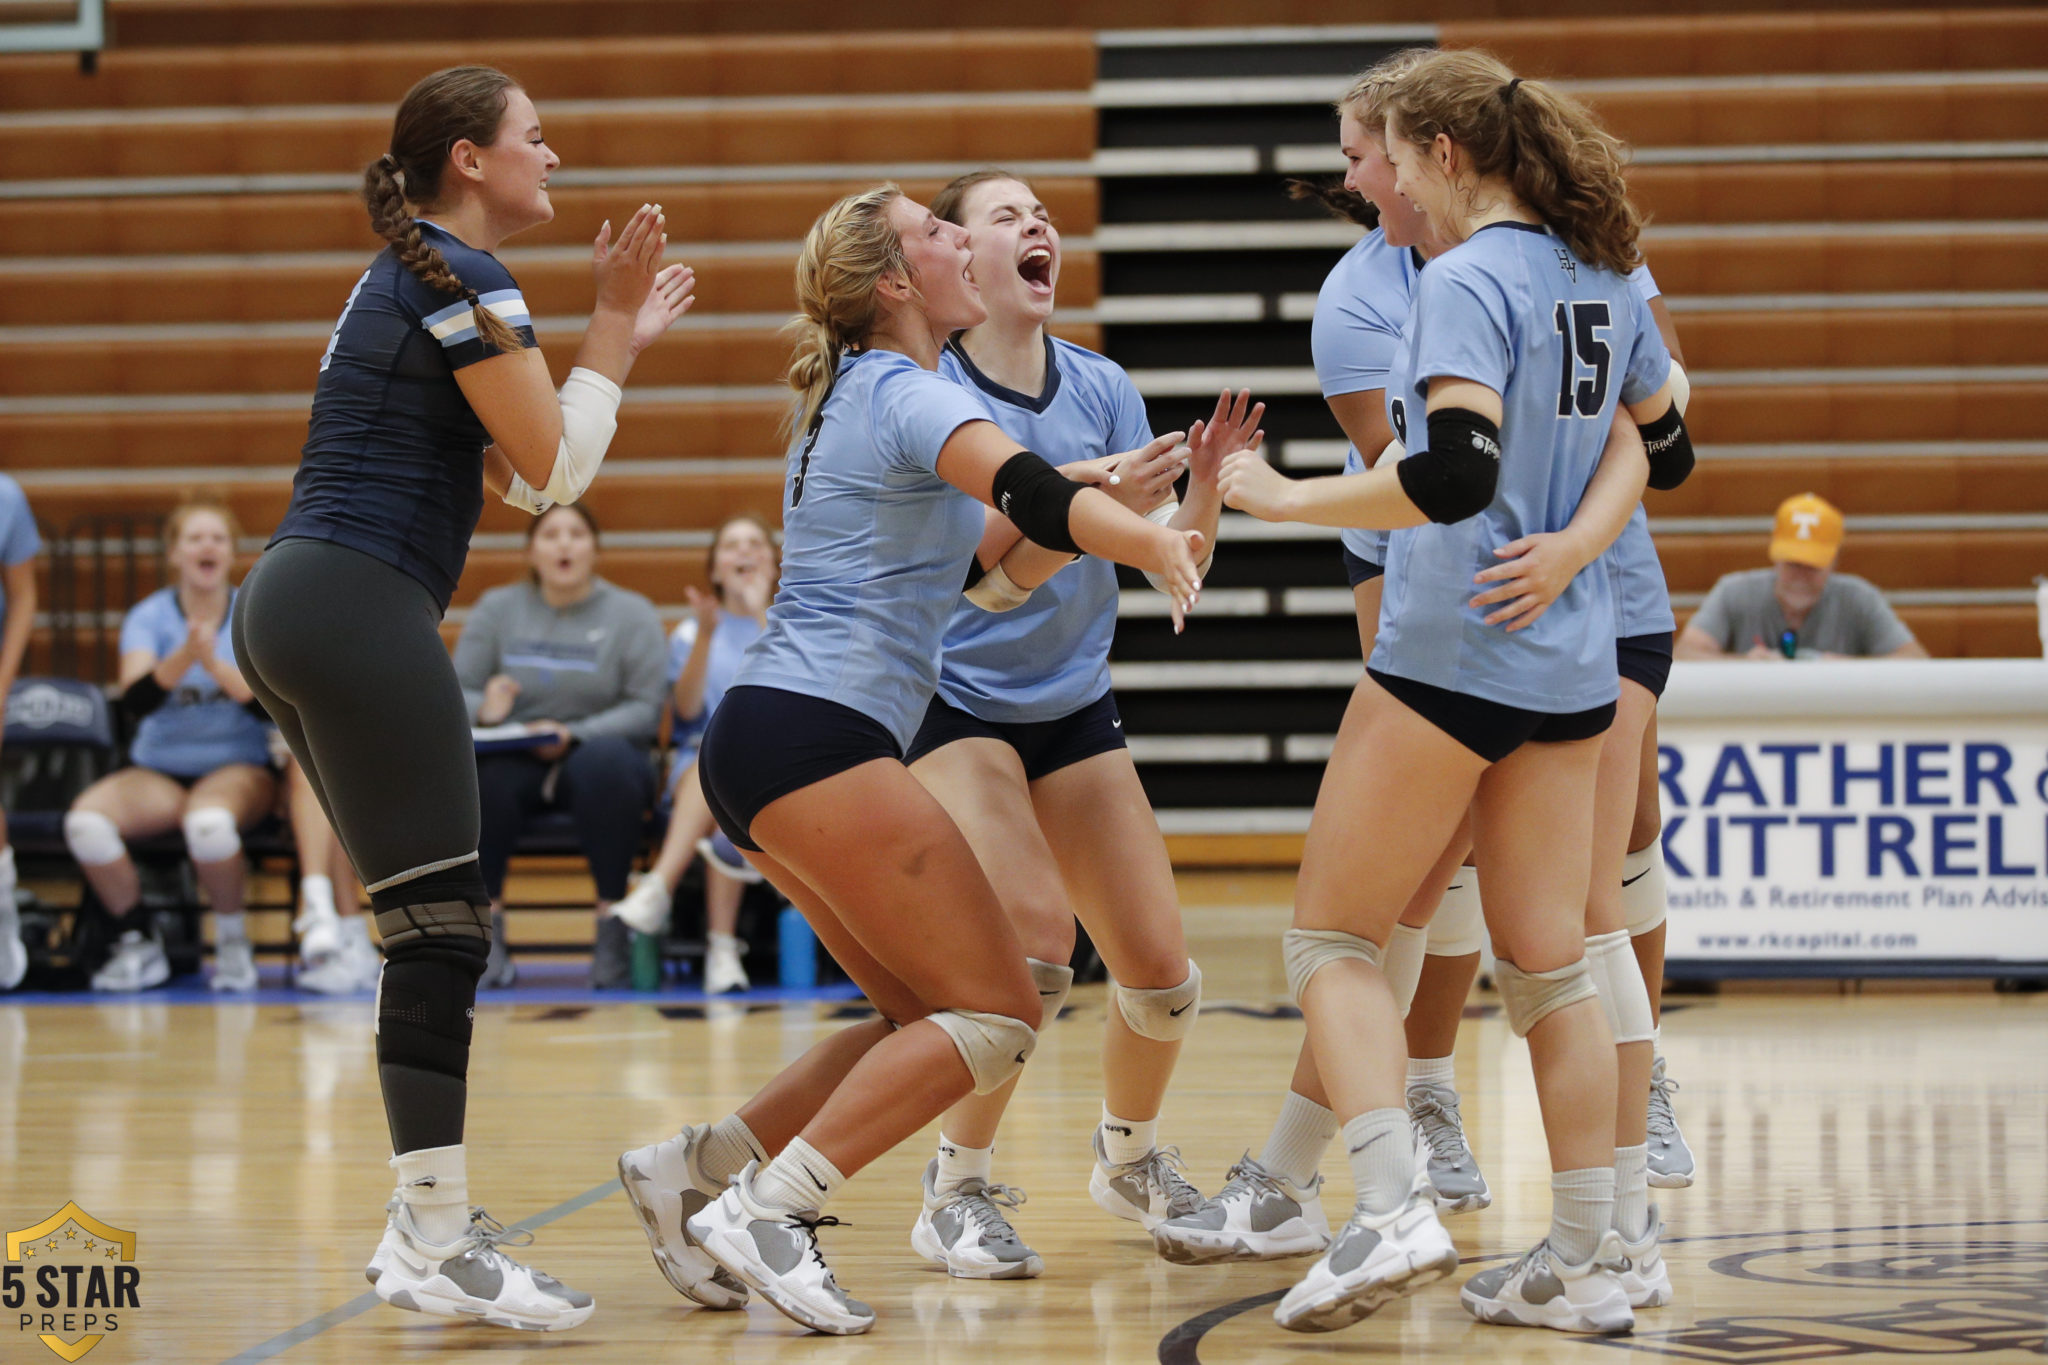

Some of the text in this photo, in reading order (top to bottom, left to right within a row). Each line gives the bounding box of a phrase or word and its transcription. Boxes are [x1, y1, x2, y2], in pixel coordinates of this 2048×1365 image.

[1552, 299, 1614, 420] 15
[1791, 510, 1821, 541] T
[1657, 743, 2018, 808] RATHER
[1661, 814, 2048, 878] KITTREL
[1667, 887, 1728, 909] ealth
[1739, 888, 1756, 908] &
[1769, 887, 1911, 909] Retirement
[1922, 886, 1974, 909] Plan
[1697, 931, 1918, 951] www.rkcapital.com
